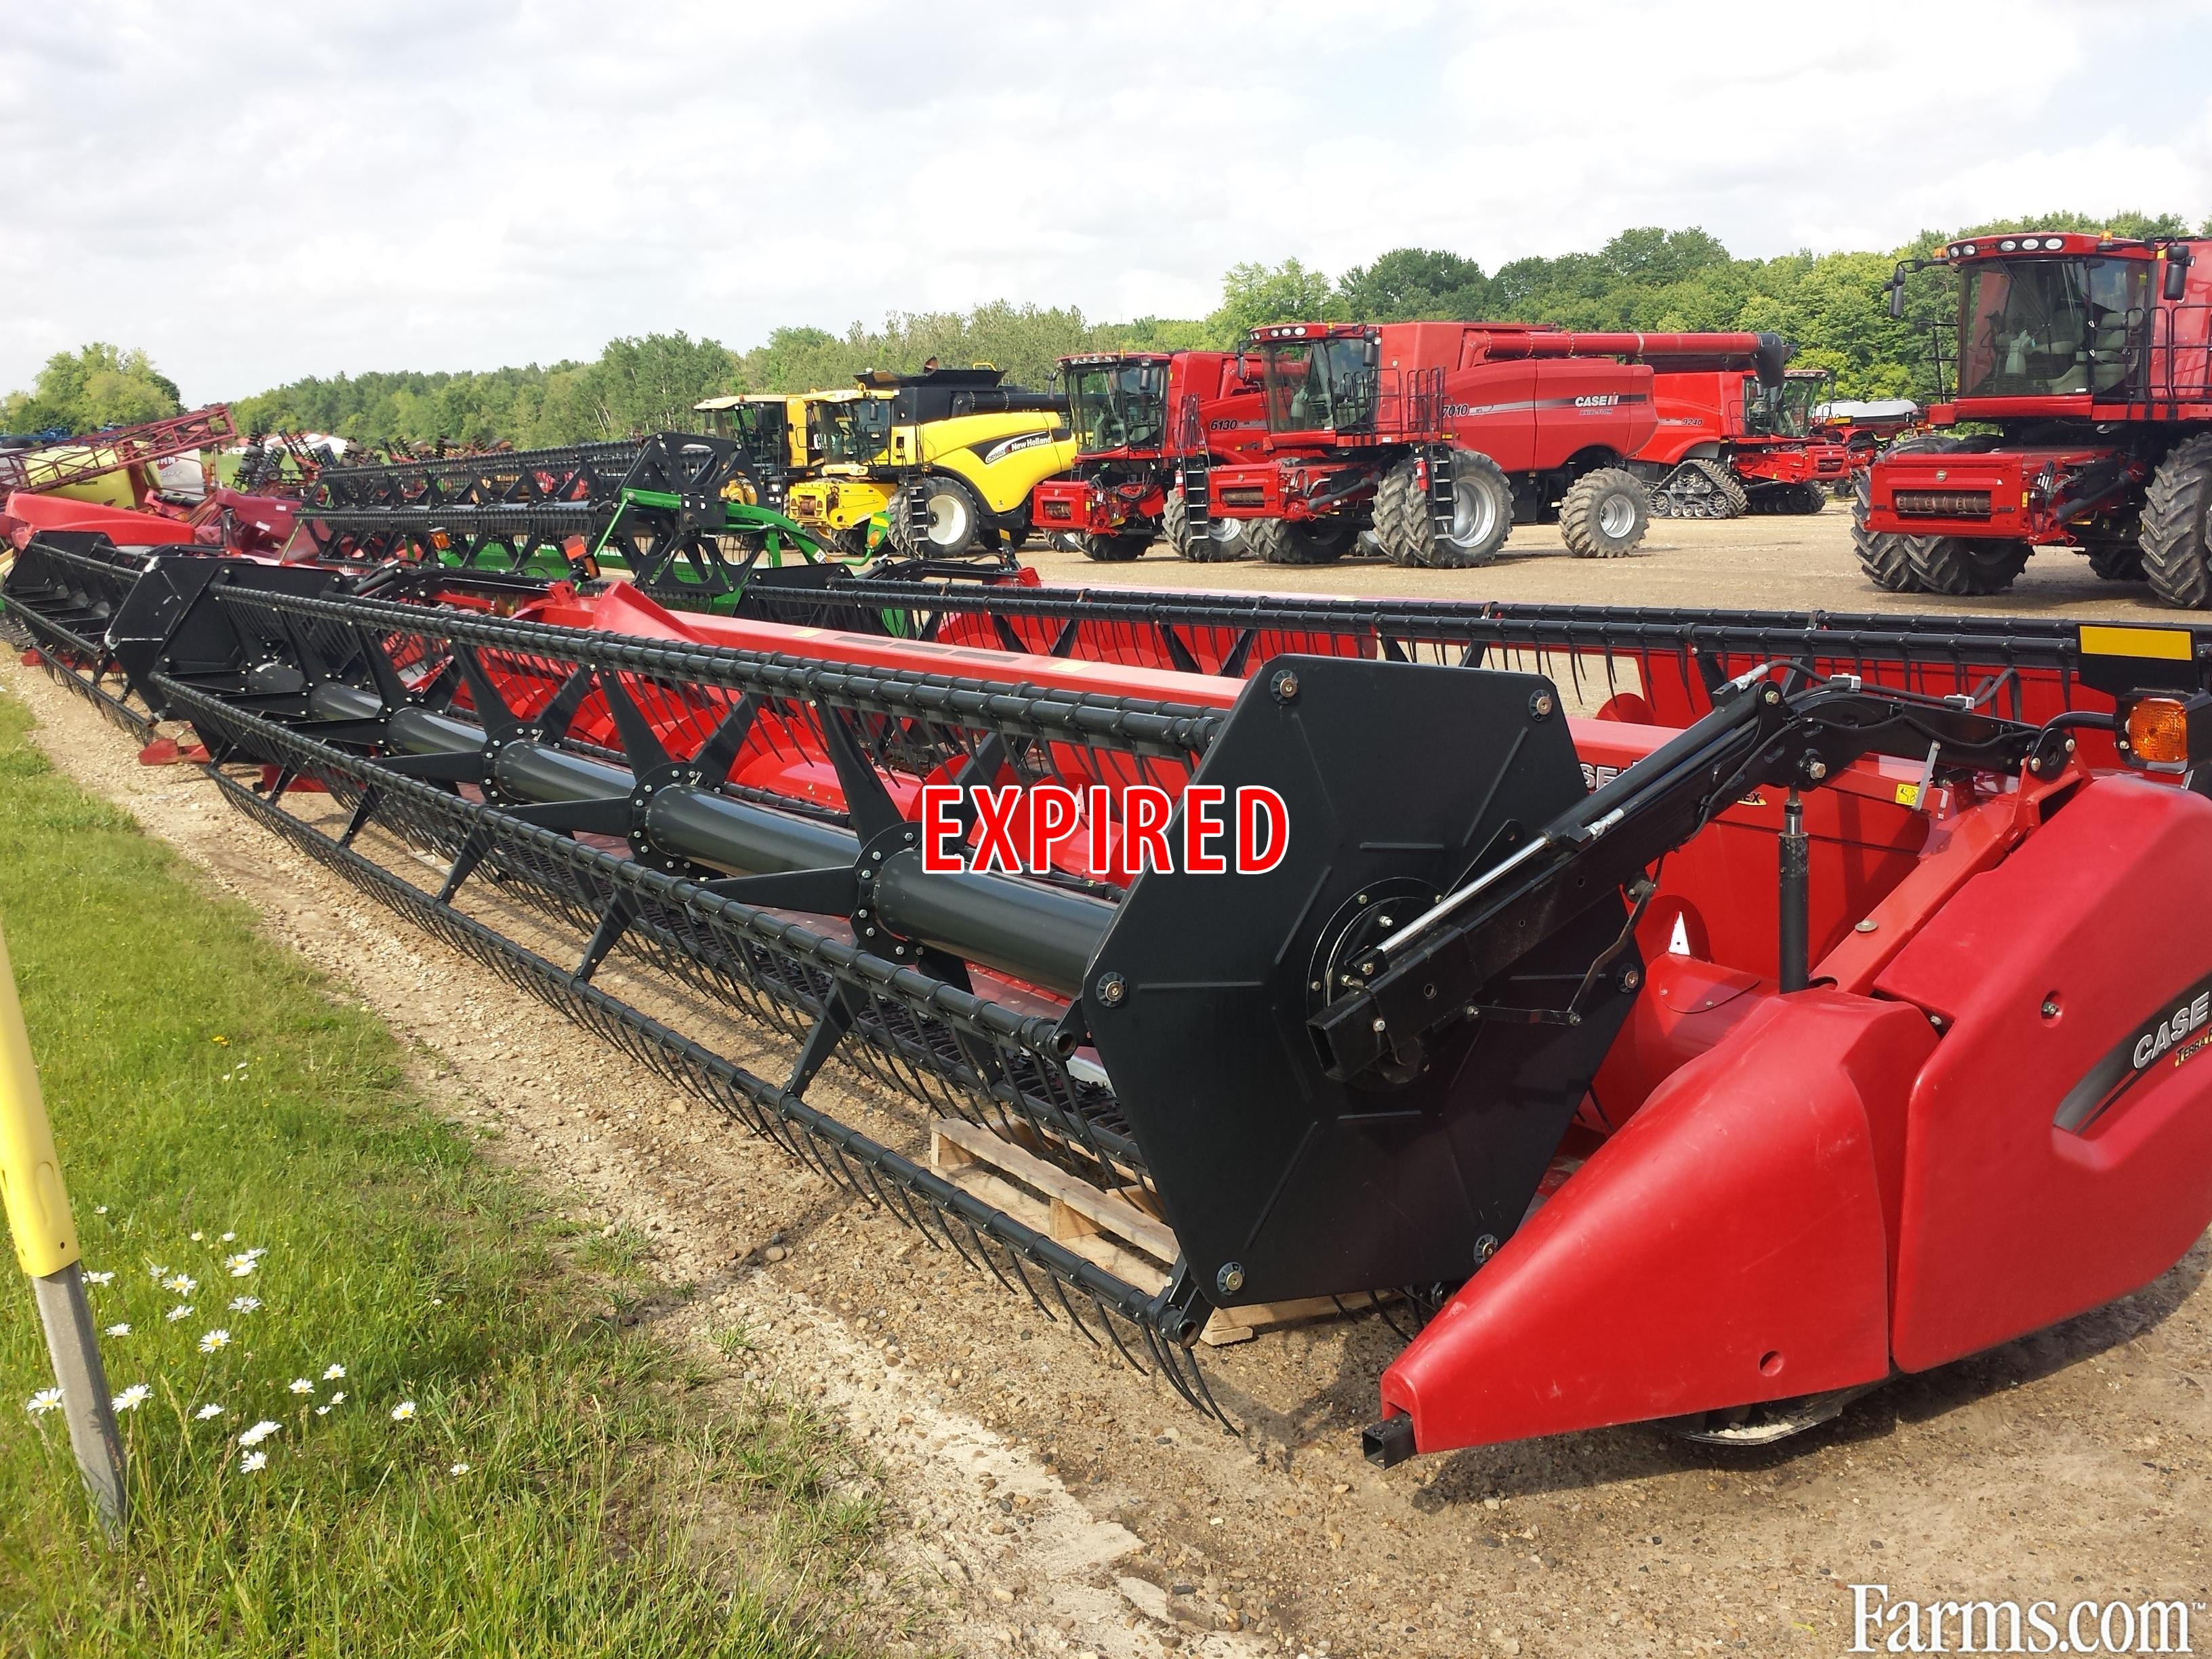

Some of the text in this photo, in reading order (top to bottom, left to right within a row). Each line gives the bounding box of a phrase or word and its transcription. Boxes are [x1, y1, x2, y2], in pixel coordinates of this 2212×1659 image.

[1575, 396, 1607, 407] CASE
[1443, 404, 1468, 417] 7010
[1210, 419, 1237, 430] 6130
[1683, 418, 1703, 426] 9240
[987, 435, 1052, 462] CR960 New Holland
[2133, 991, 2209, 1069] CASE
[2176, 1036, 2205, 1063] TERRA
